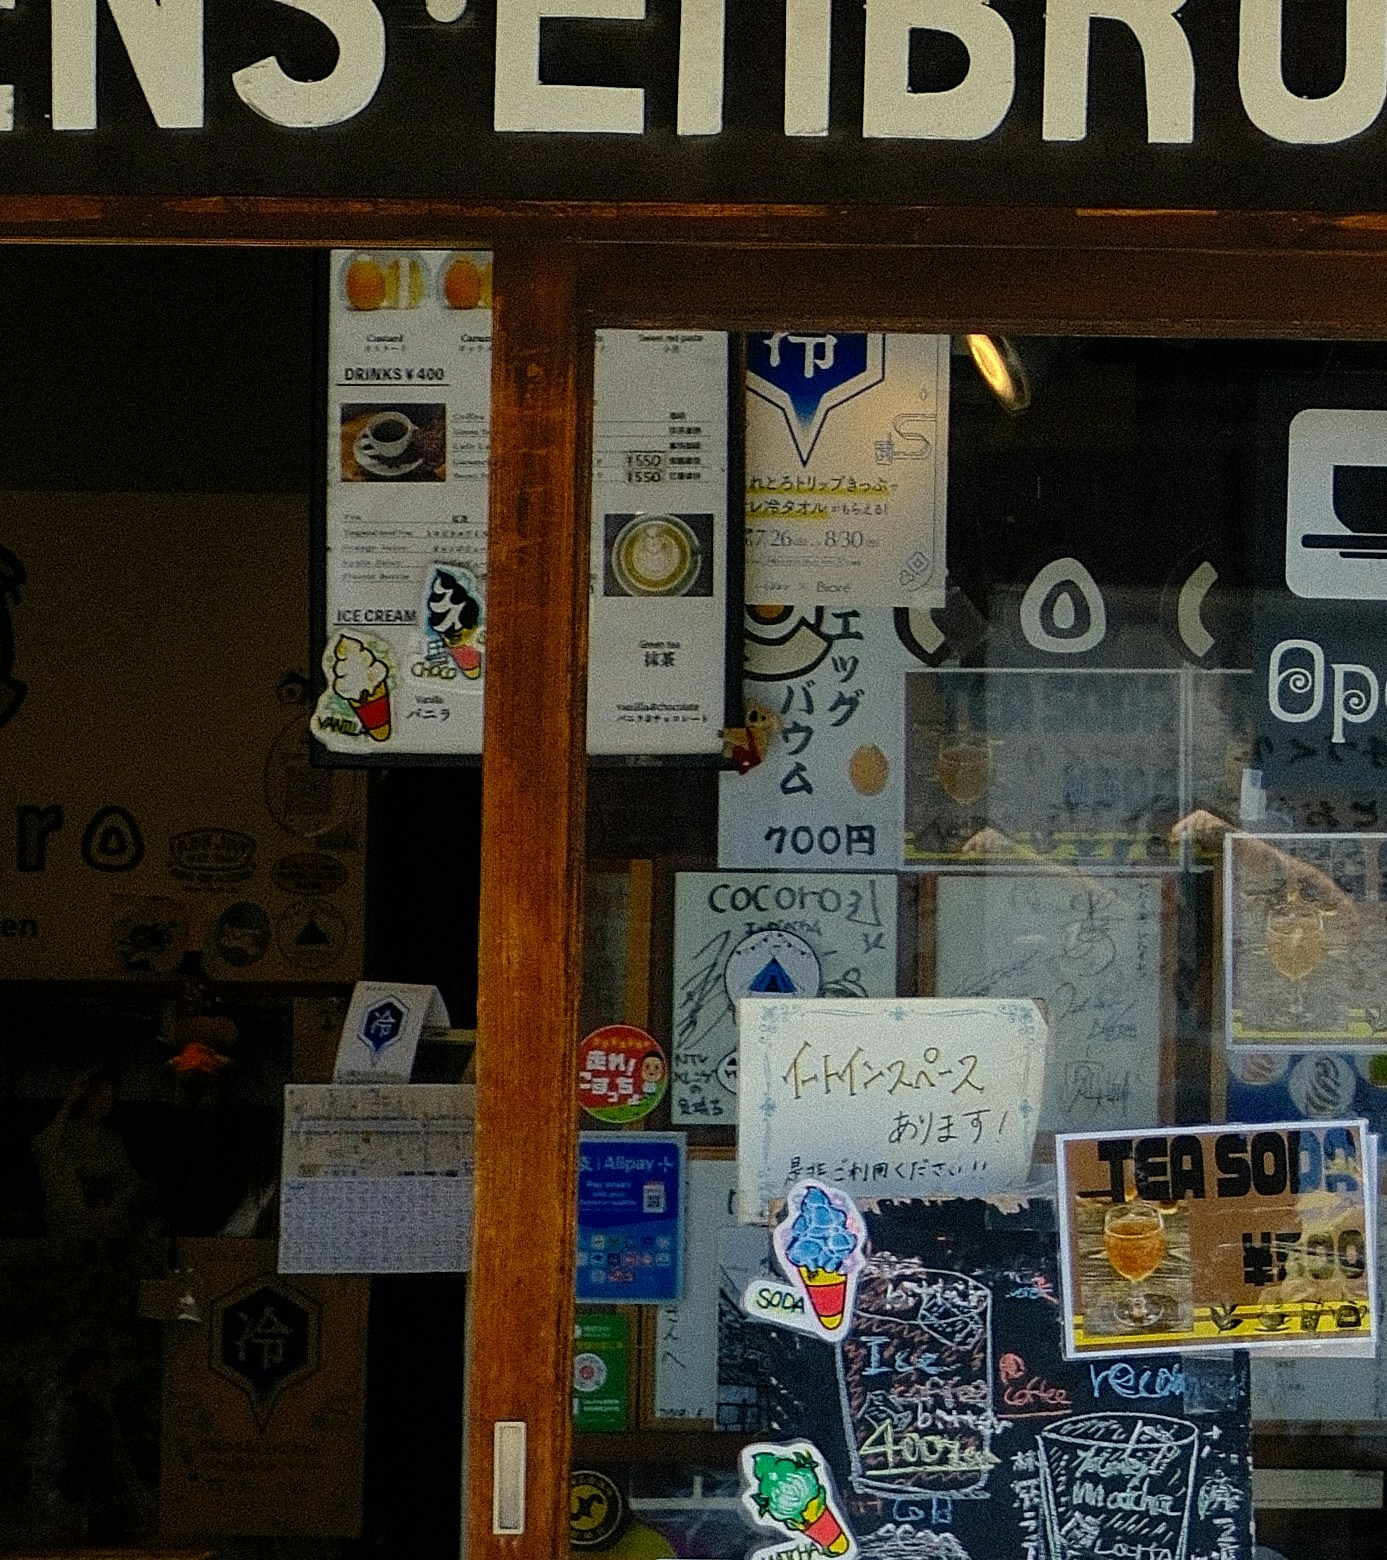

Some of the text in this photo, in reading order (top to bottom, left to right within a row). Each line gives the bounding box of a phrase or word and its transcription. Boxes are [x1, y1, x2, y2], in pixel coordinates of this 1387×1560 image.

[344, 367, 402, 381] DRINKS
[337, 610, 416, 622] ICE CREAM
[407, 707, 451, 721] バニラ
[780, 680, 816, 796] バウム
[764, 823, 877, 857] 700円
[781, 1040, 986, 1100] イートインスペース
[887, 1107, 1009, 1147] あります!
[1097, 1127, 1358, 1203] TEA SODA
[756, 1288, 806, 1314] SODA
